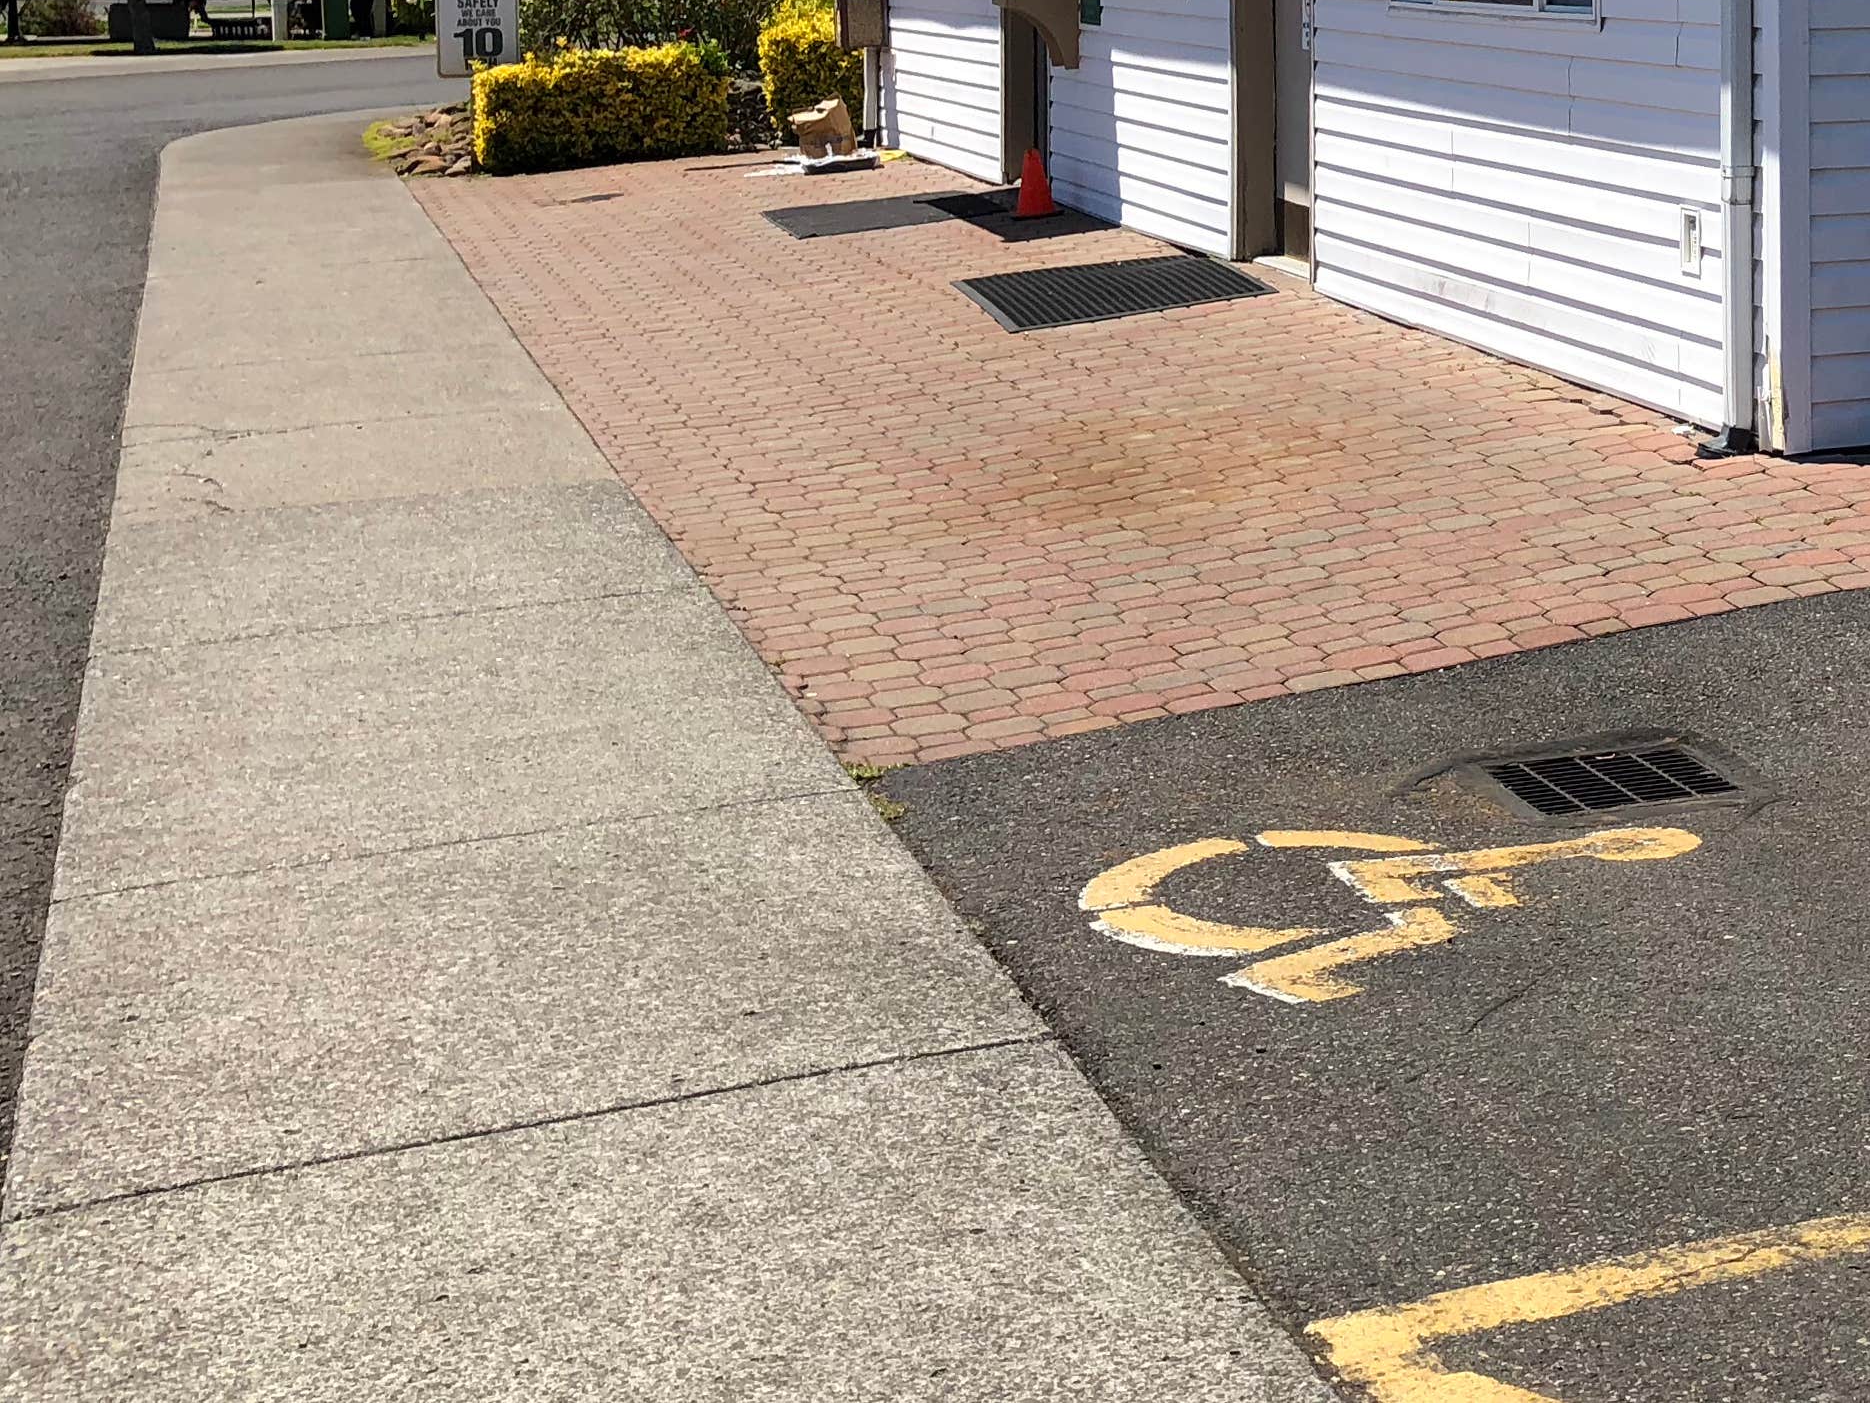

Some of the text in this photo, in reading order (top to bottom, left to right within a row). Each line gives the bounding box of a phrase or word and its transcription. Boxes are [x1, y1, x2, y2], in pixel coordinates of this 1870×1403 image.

[461, 8, 497, 18] WE CARE
[456, 17, 502, 27] ABOUT YOU
[453, 27, 504, 57] 10
